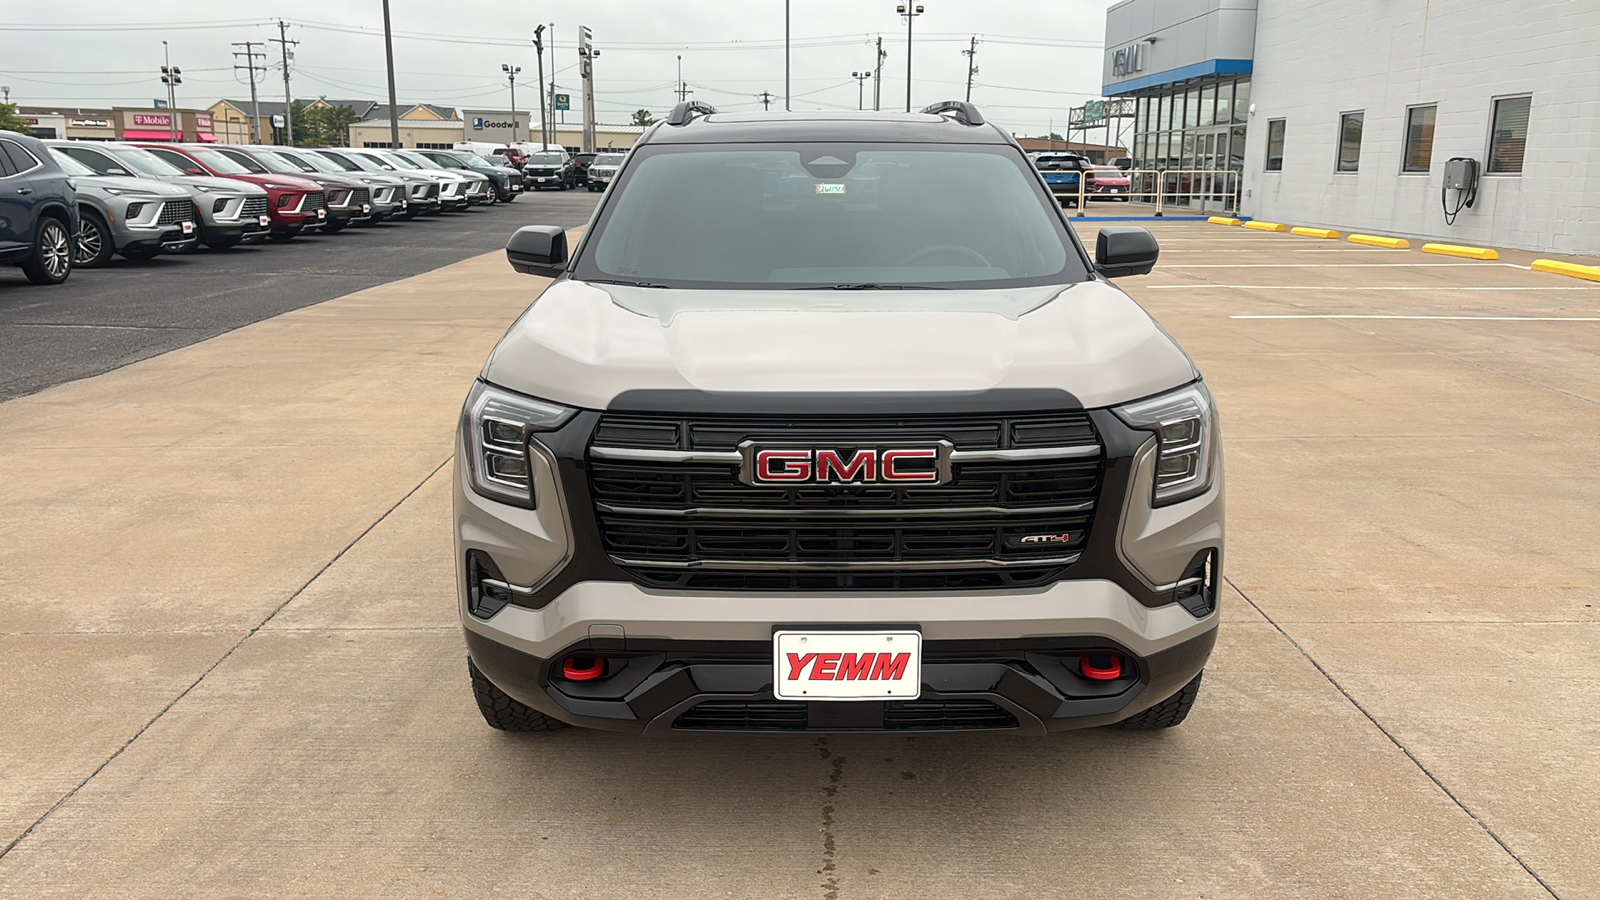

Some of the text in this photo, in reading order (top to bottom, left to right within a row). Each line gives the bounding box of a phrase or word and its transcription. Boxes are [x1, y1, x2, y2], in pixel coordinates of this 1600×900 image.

[483, 120, 520, 129] Goodwll
[756, 449, 937, 481] GMC
[1020, 533, 1069, 543] AT4
[786, 652, 911, 681] YEMM
